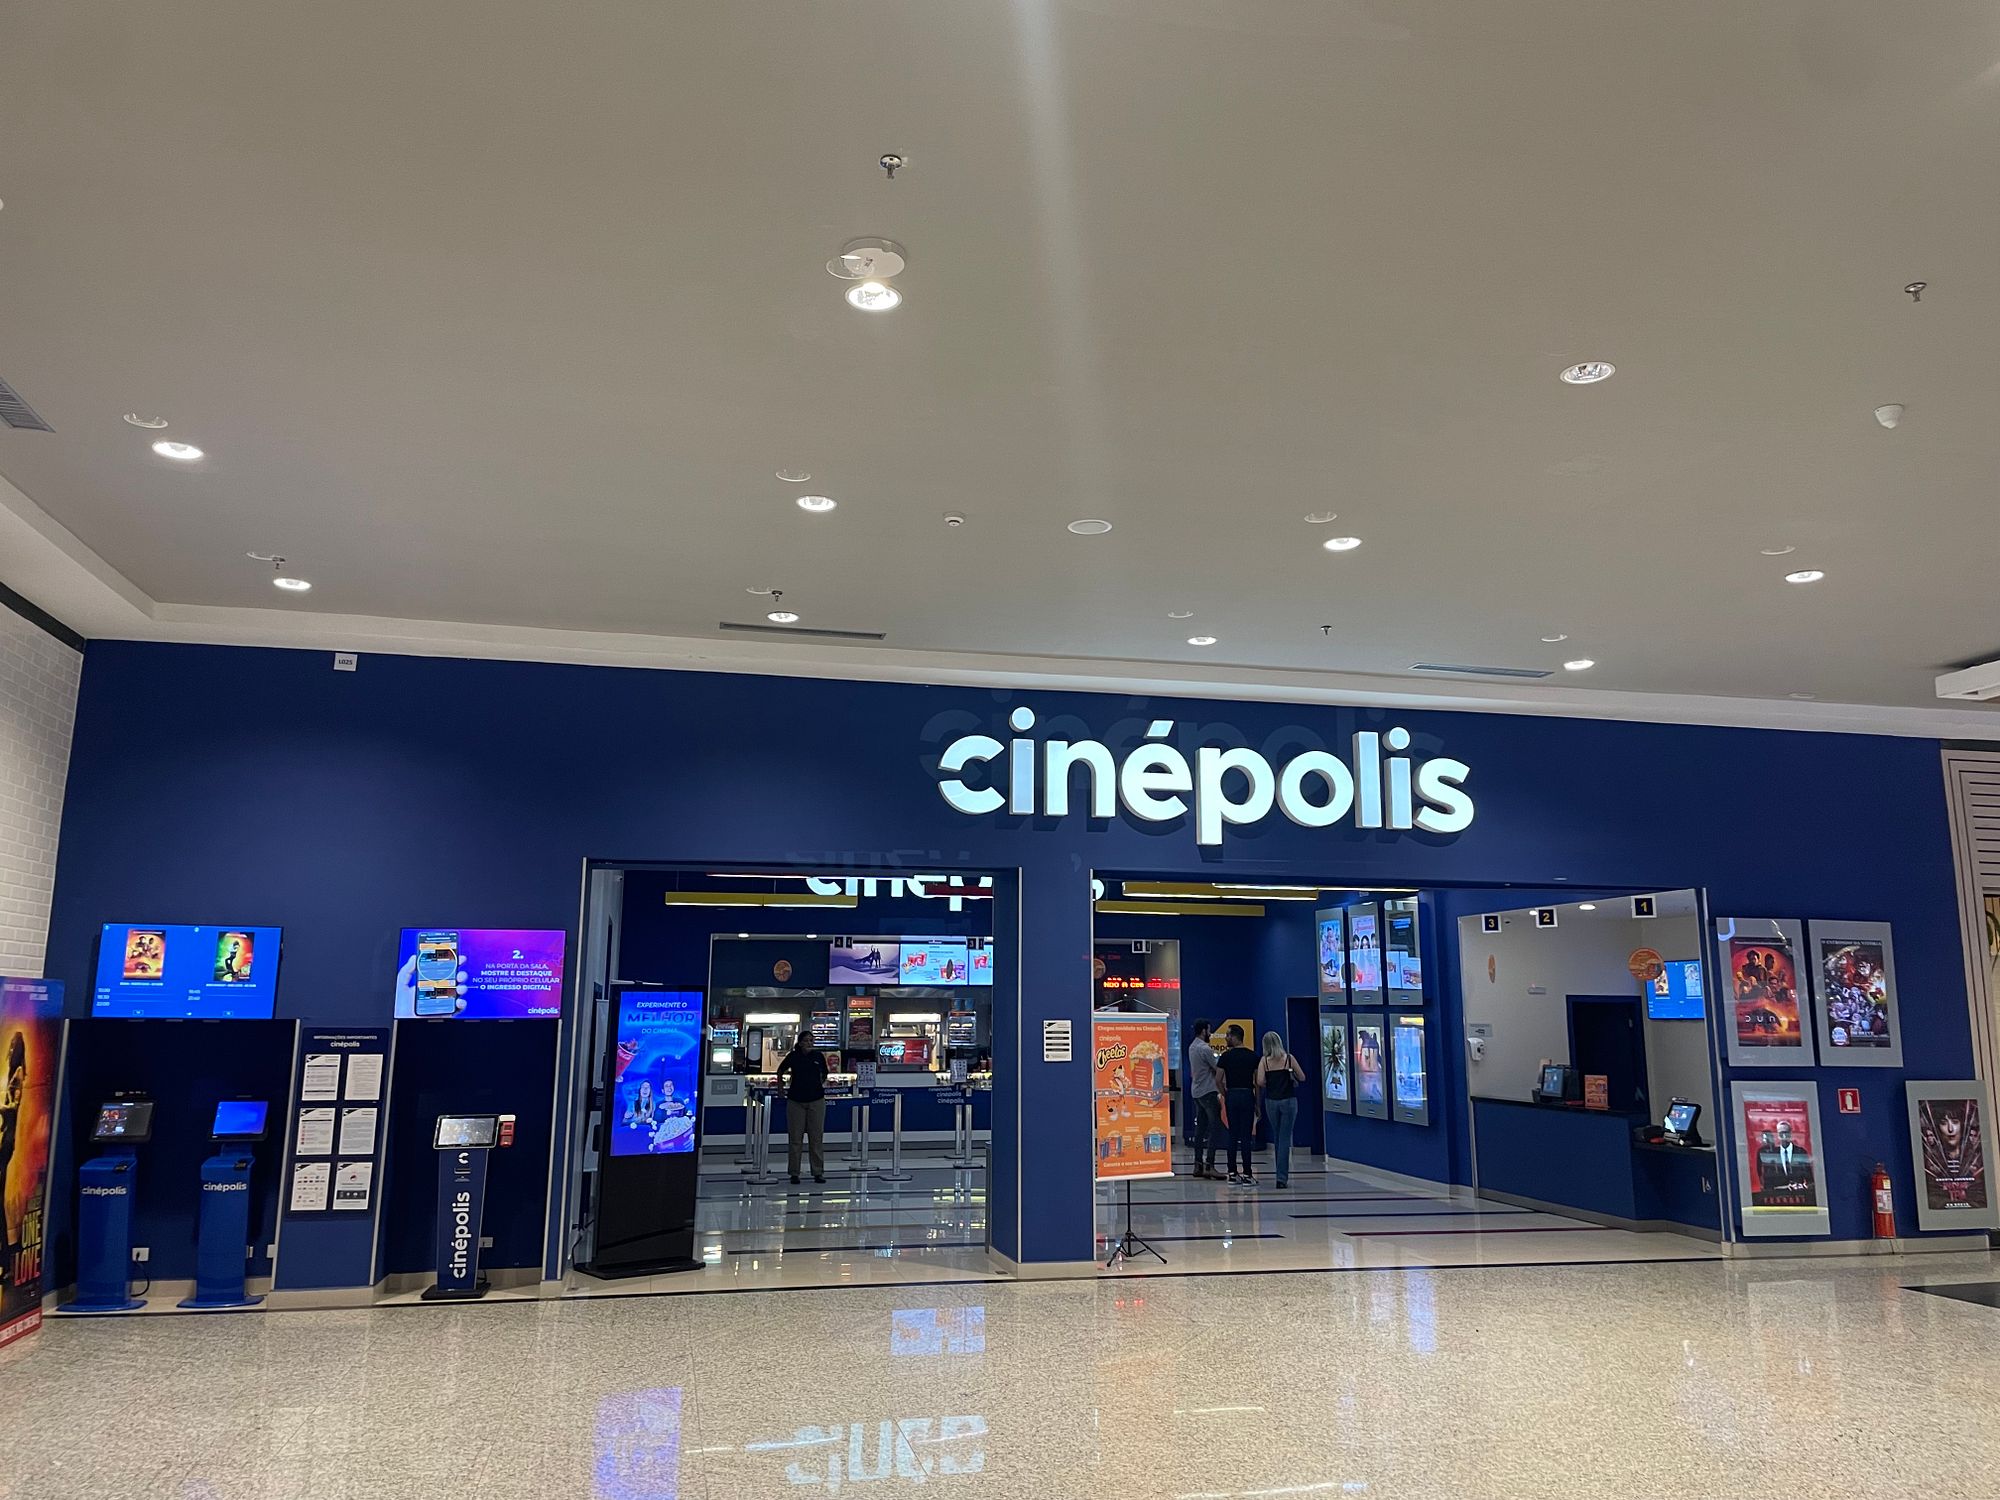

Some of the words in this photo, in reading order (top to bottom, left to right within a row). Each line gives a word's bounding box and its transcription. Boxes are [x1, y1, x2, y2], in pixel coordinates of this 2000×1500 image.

[937, 706, 1475, 846] cinépolis
[1641, 901, 1648, 912] 1
[1488, 919, 1495, 928] 3
[1543, 913, 1551, 923] 2
[512, 949, 524, 960] 2.
[528, 1007, 559, 1015] cinépolis
[1096, 1043, 1127, 1070] Cheetos
[81, 1185, 128, 1197] cinépolis
[203, 1181, 248, 1193] cinépolis
[21, 1209, 42, 1250] ONE
[449, 1191, 472, 1279] cinépolis
[14, 1243, 41, 1287] LOVE
